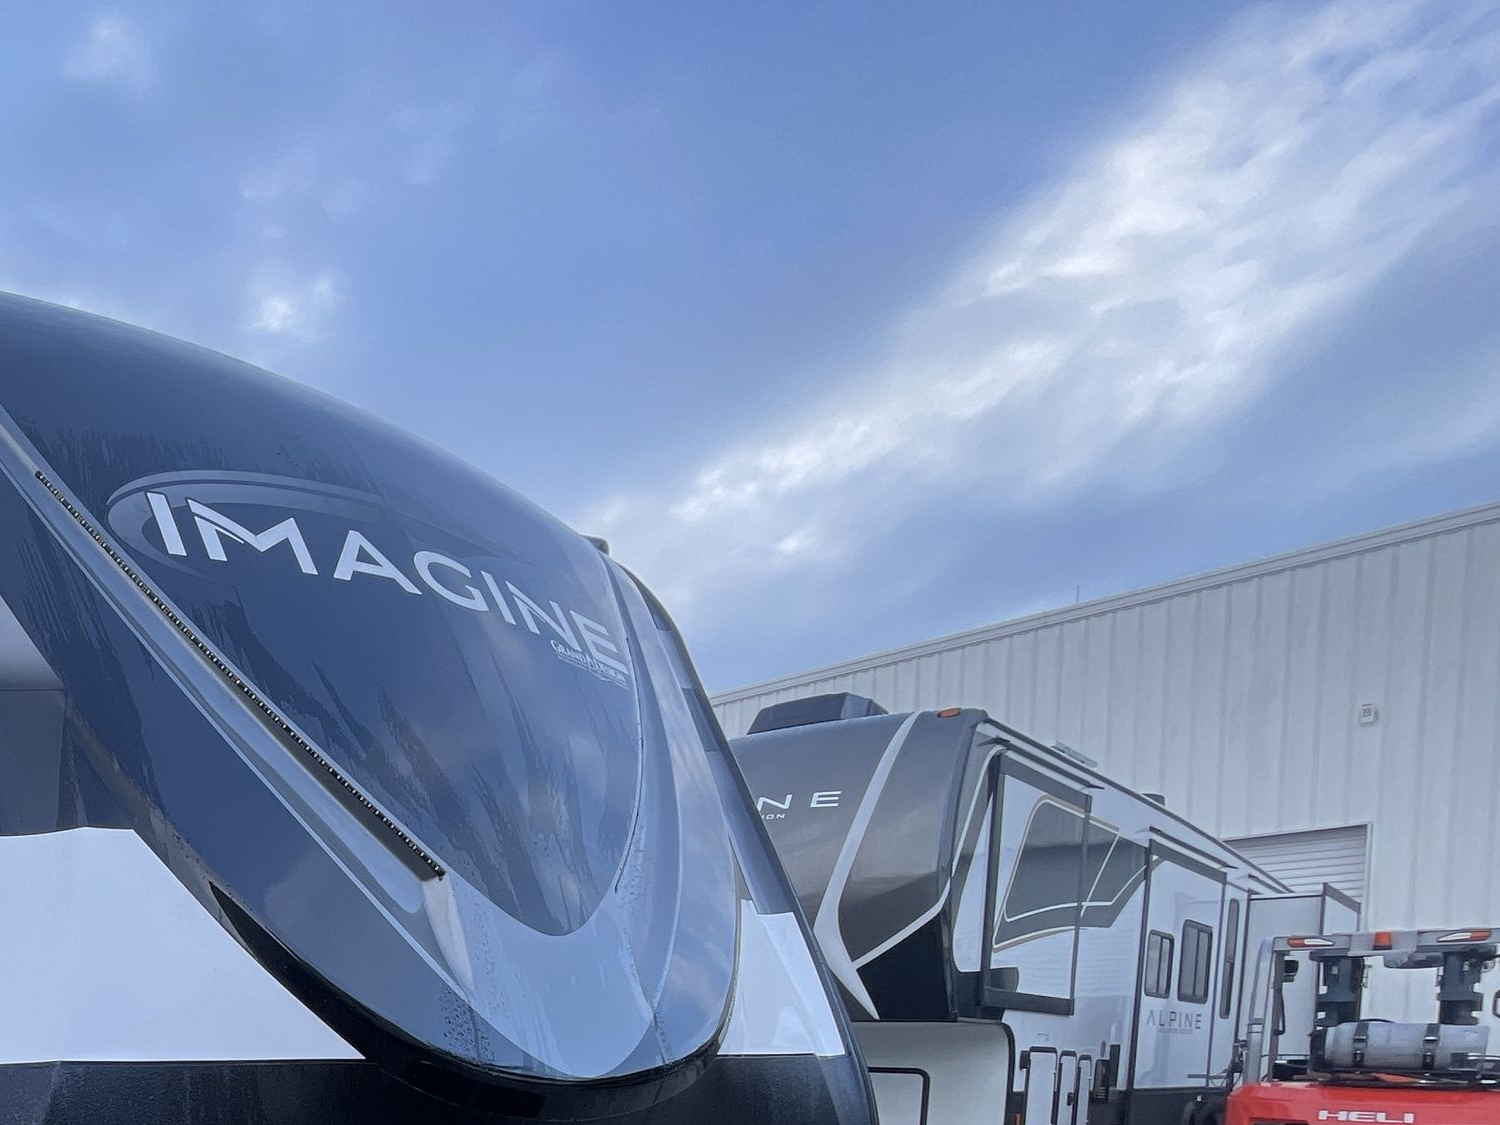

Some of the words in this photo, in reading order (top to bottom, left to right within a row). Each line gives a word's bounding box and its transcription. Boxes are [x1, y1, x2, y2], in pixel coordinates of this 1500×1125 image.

[146, 491, 629, 674] IMAGINE
[1146, 1009, 1202, 1029] ALPINE
[1318, 1109, 1415, 1124] HELI
